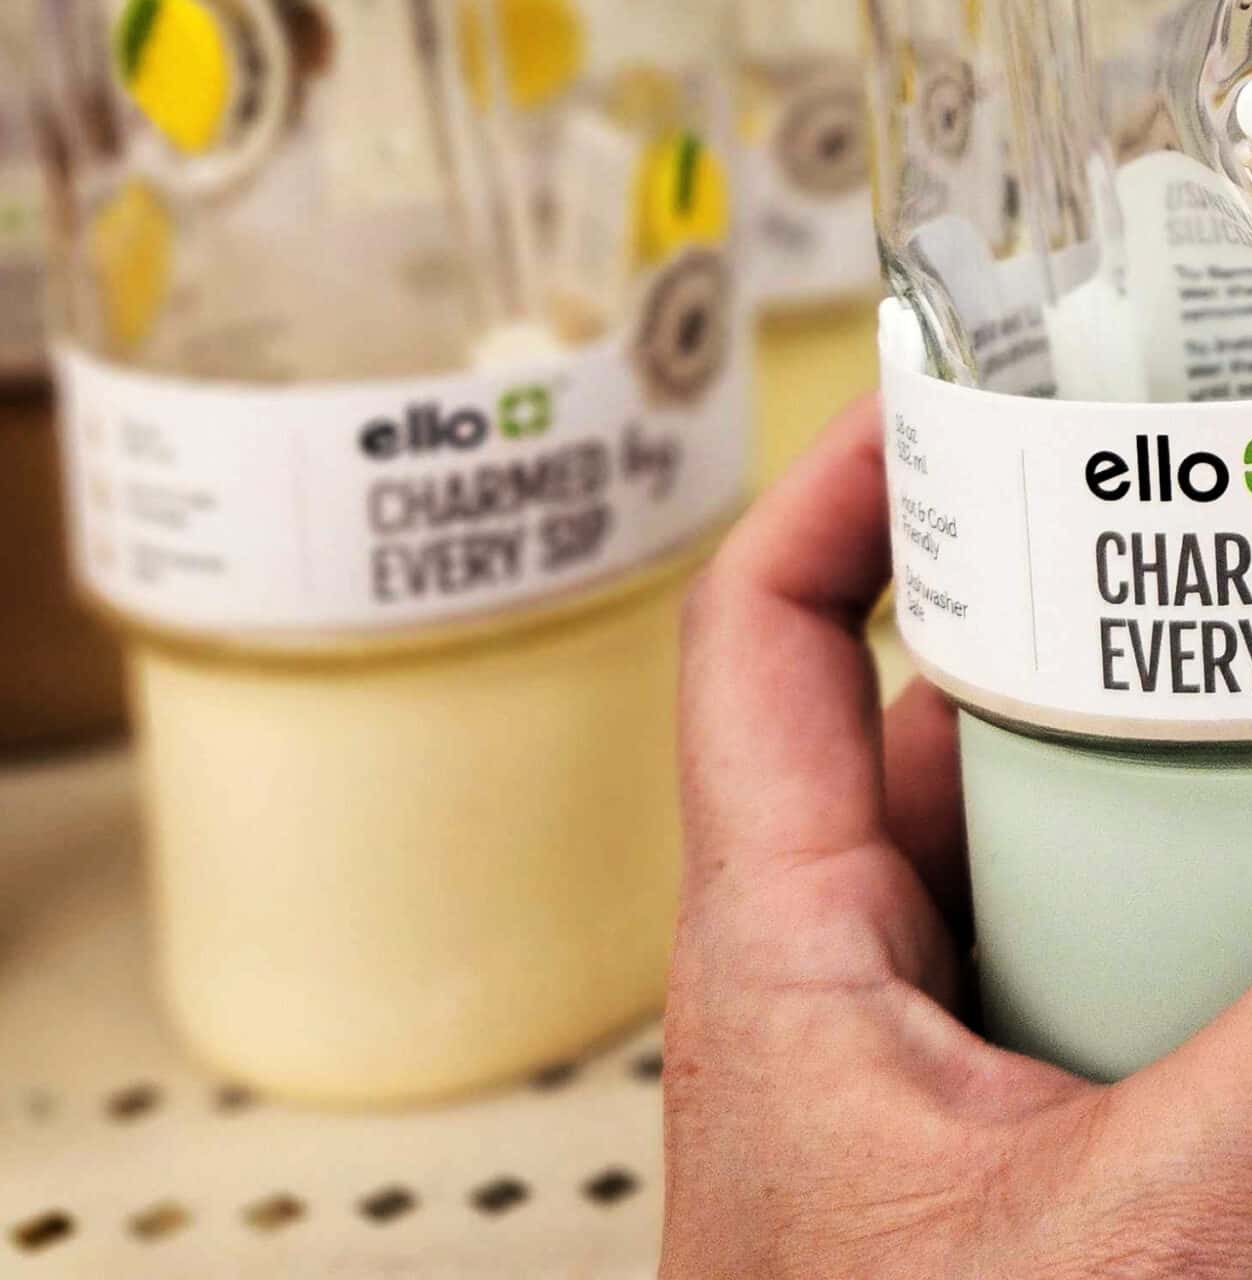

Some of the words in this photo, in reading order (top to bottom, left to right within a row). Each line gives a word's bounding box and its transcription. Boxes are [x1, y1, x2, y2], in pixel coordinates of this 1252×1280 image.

[359, 401, 489, 460] ello
[1085, 434, 1230, 502] ello
[927, 507, 958, 538] Cold
